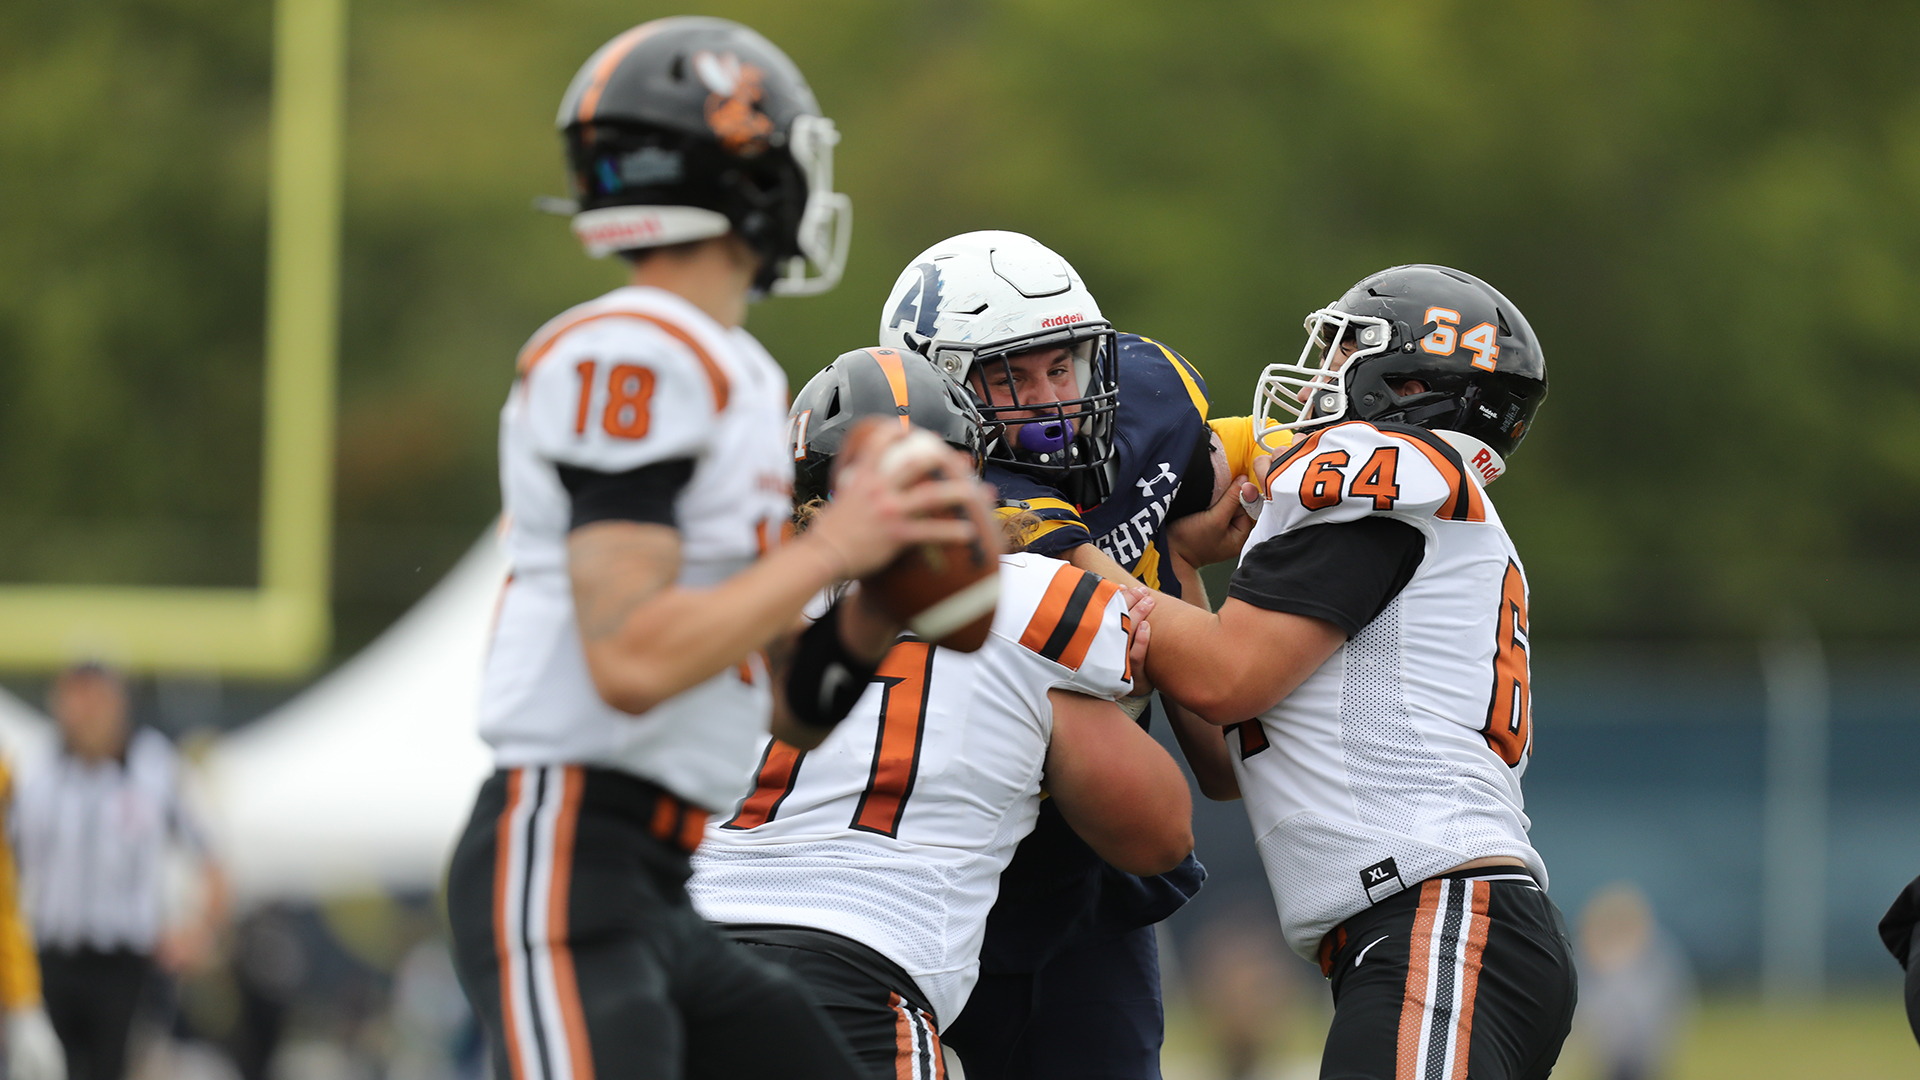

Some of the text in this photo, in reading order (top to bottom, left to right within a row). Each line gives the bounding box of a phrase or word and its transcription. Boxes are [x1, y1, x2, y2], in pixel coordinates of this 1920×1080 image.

[1041, 313, 1084, 328] Riddell
[1420, 306, 1500, 373] 64
[573, 359, 657, 442] 18
[1299, 446, 1400, 512] 64
[1480, 555, 1532, 768] 6
[1368, 867, 1390, 883] XL
